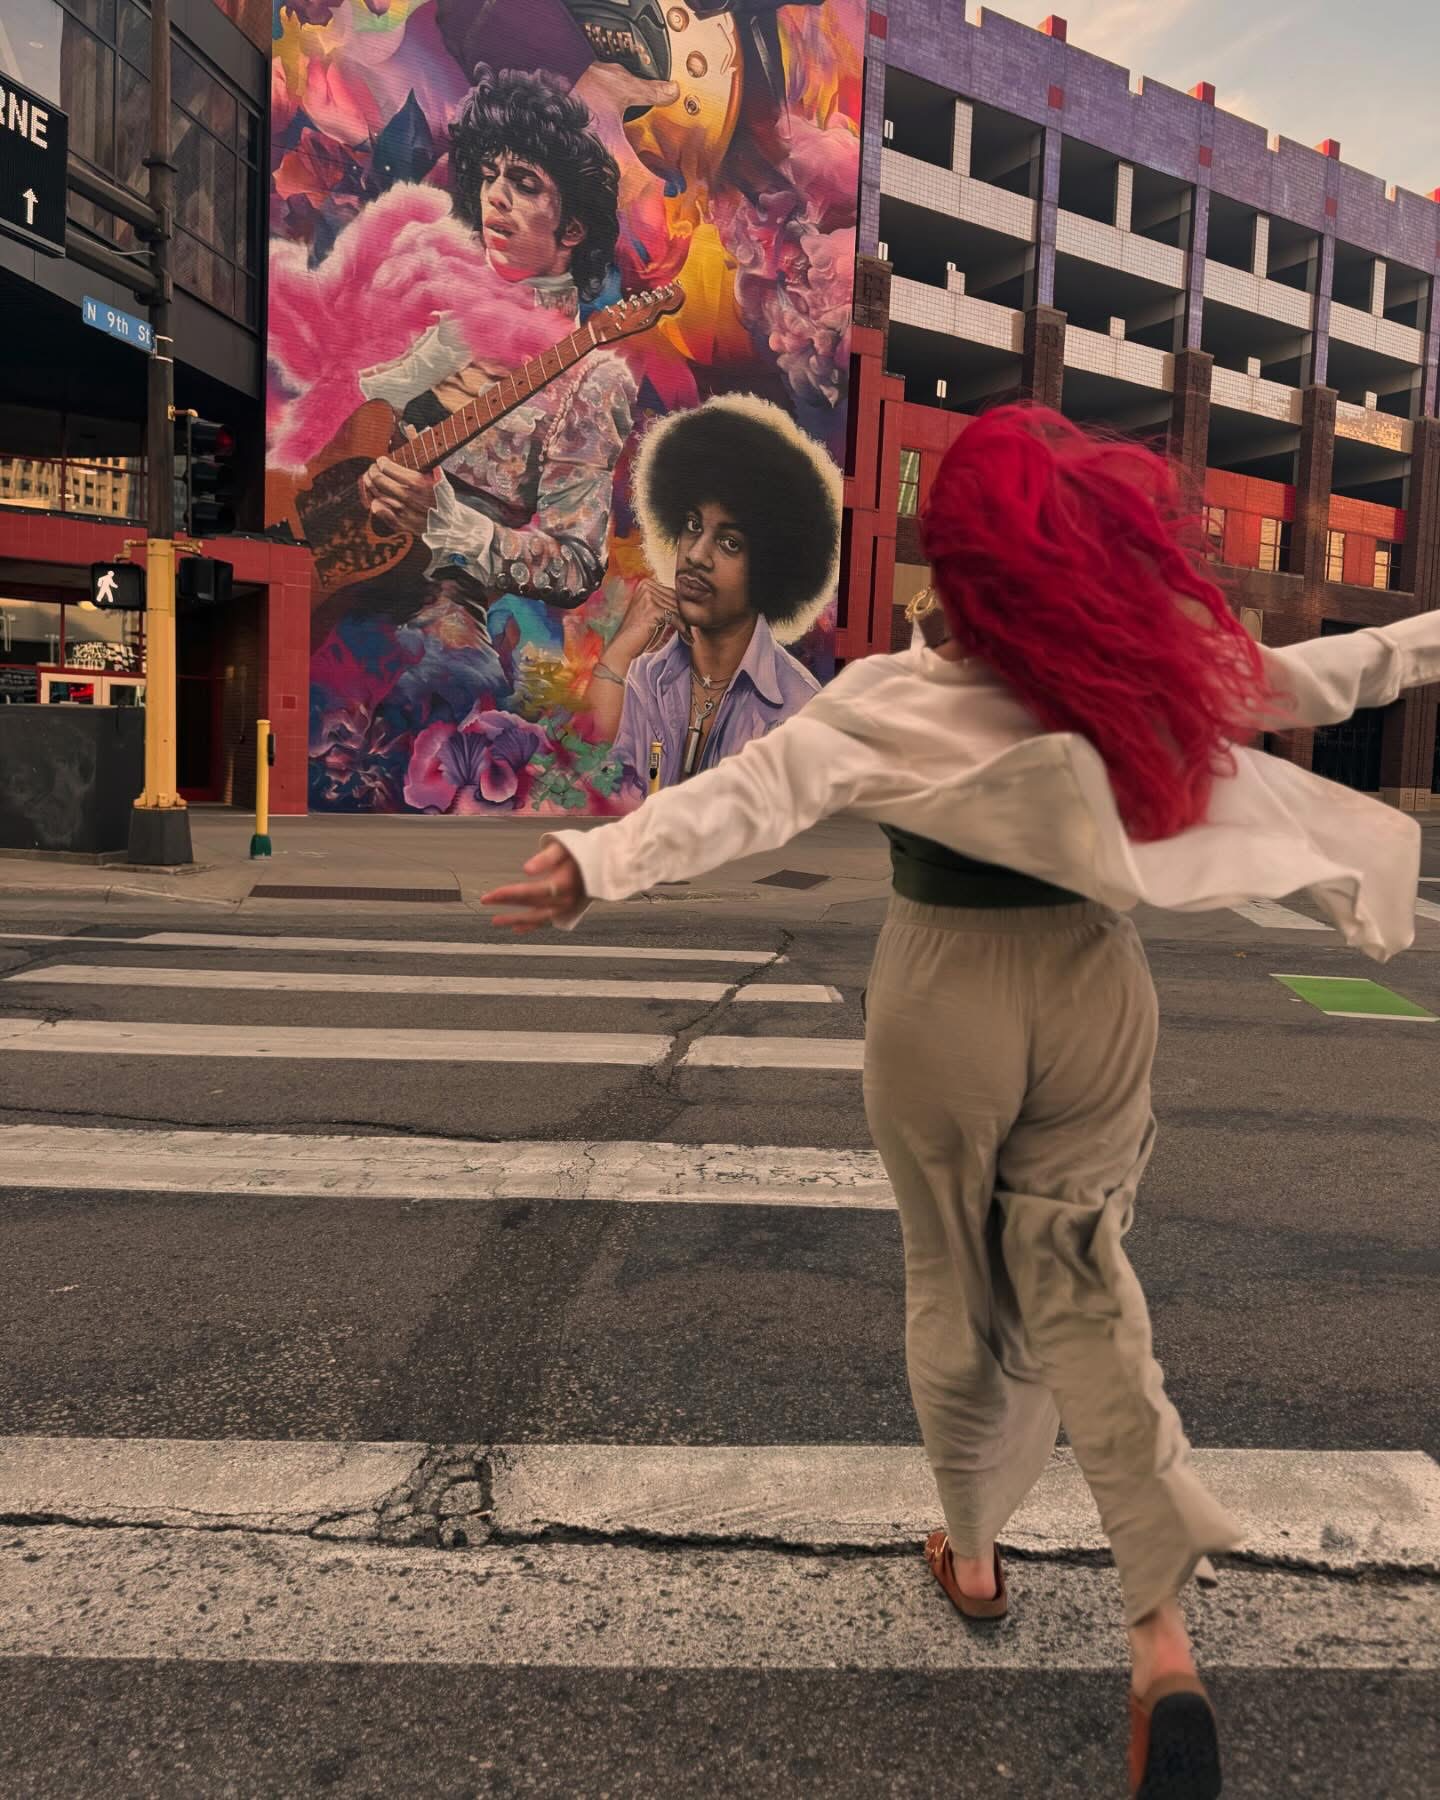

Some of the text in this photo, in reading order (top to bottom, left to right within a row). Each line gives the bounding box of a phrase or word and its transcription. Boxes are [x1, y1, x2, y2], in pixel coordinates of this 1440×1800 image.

[87, 302, 150, 344] N 9th St
